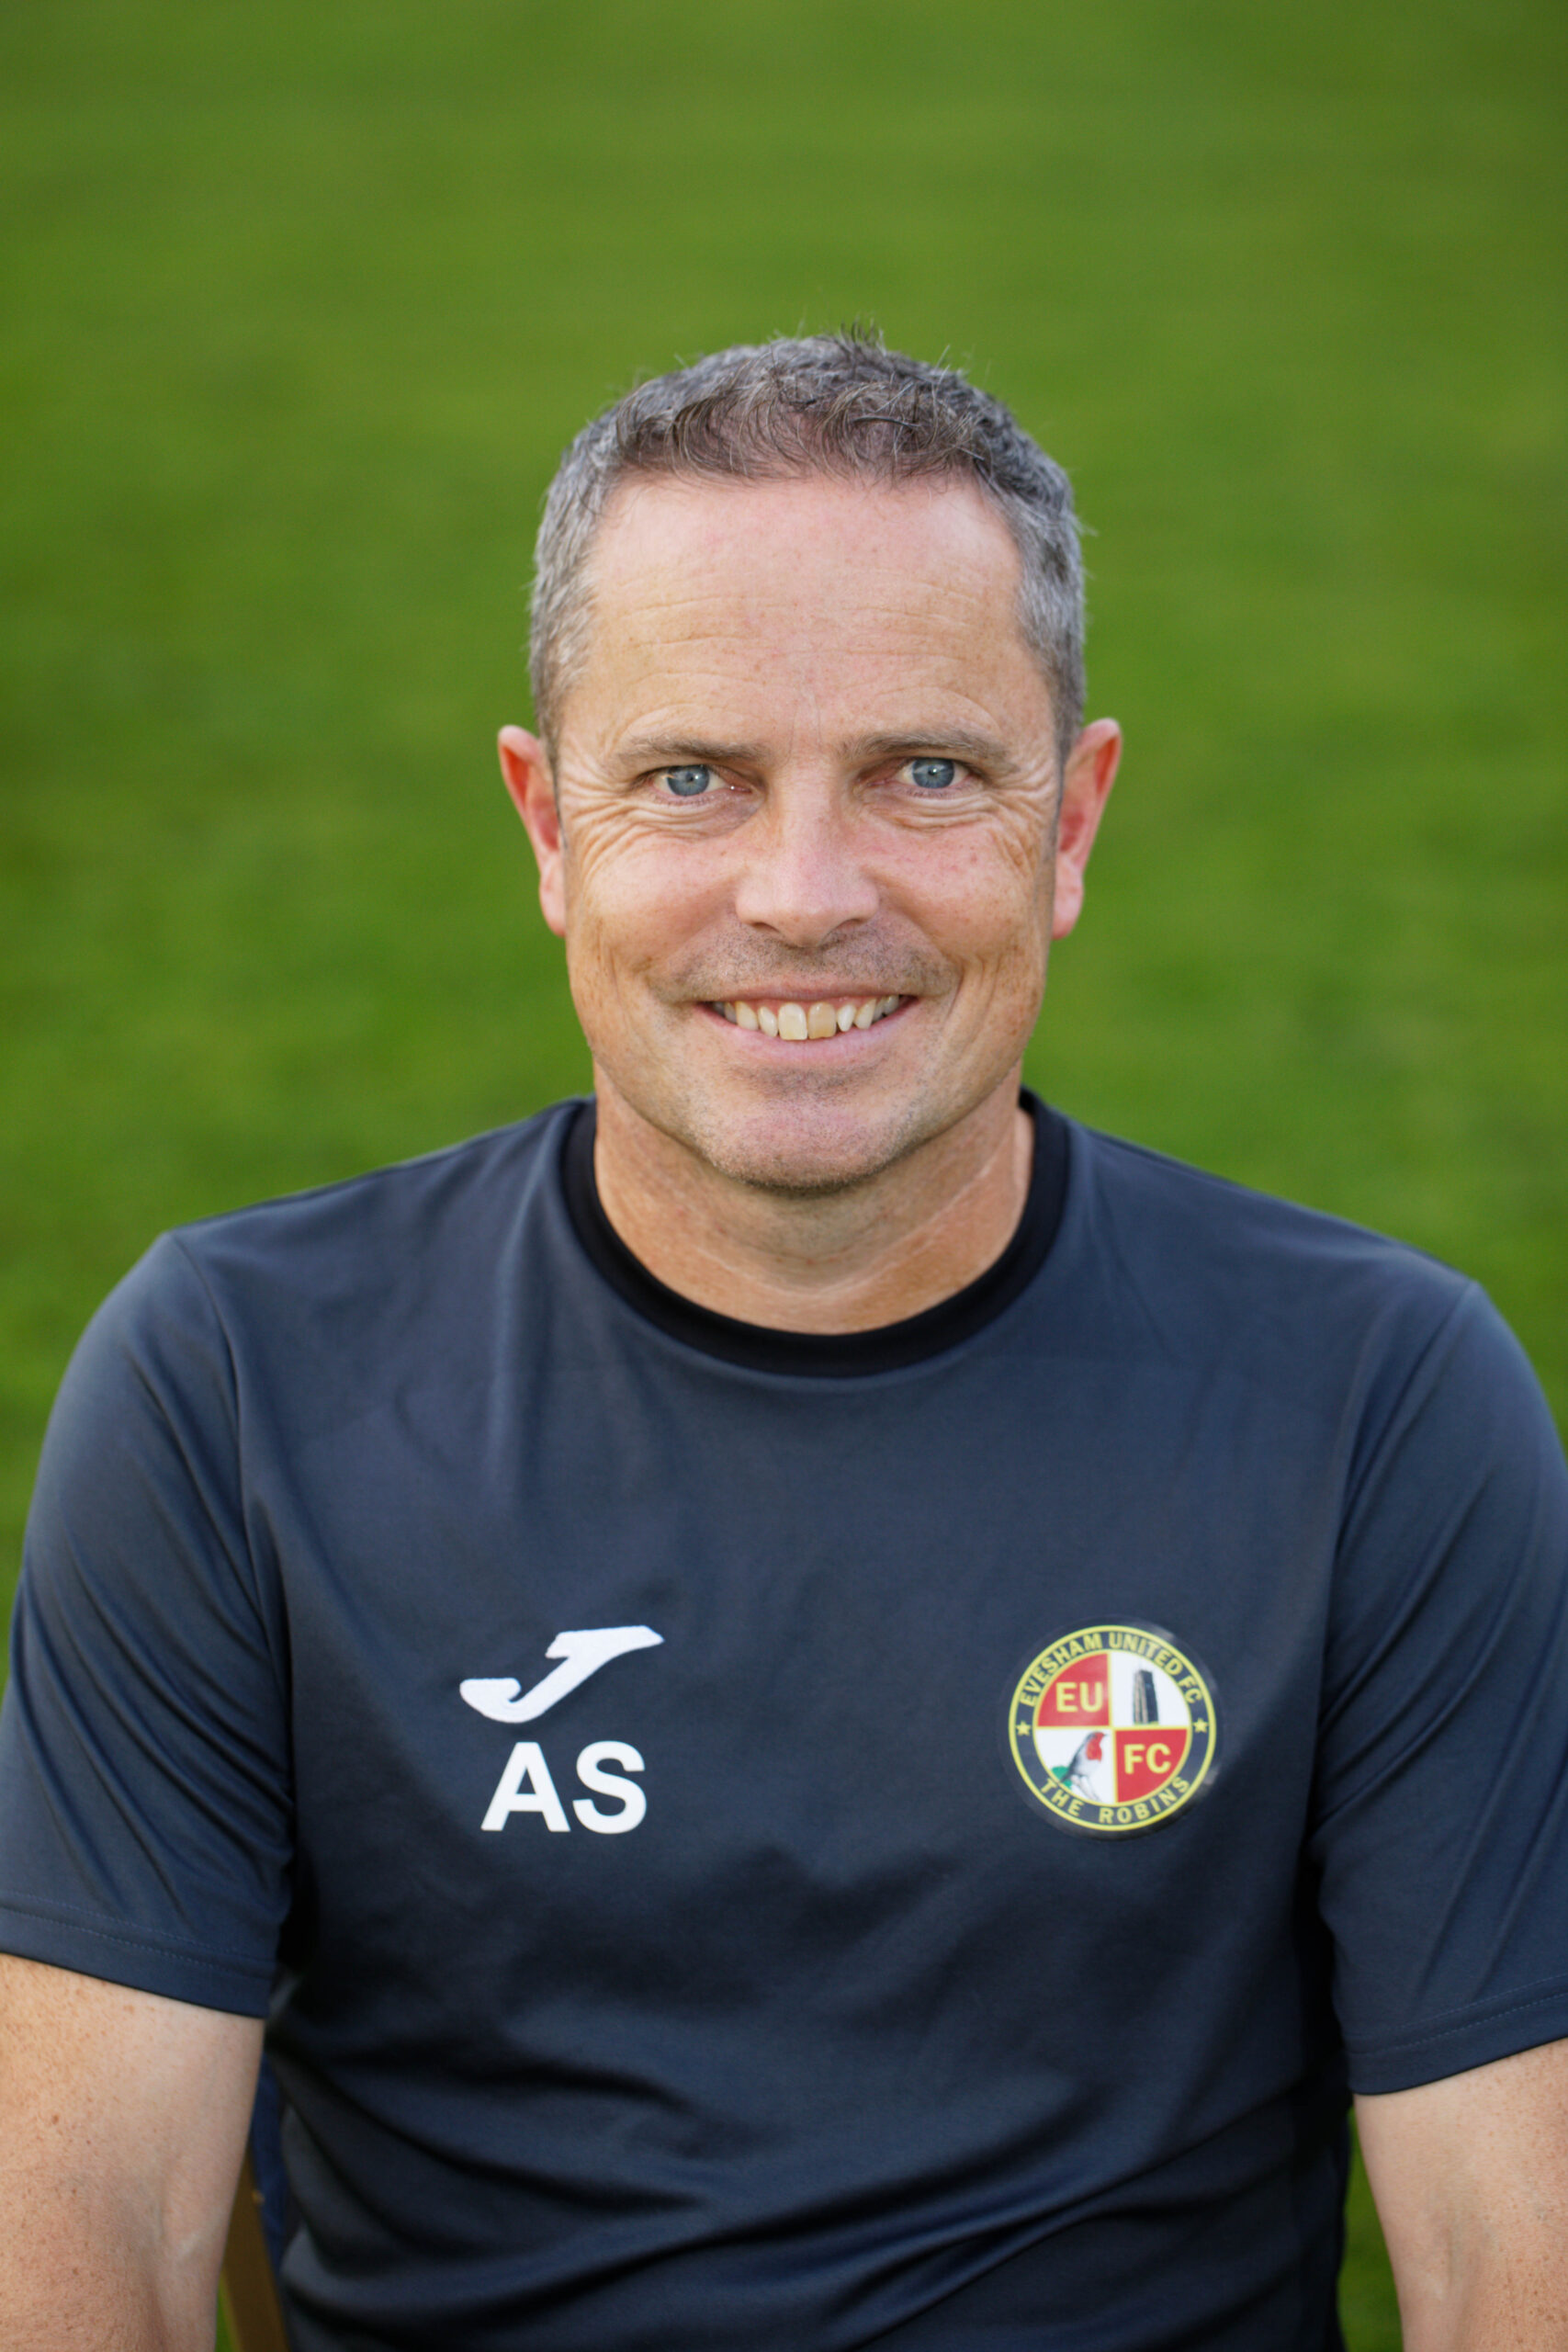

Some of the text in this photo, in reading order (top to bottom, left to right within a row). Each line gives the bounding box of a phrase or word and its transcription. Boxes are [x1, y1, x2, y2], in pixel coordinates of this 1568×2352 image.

[1020, 1632, 1202, 1707] EVESHAM UNITED FC
[1055, 1681, 1103, 1713] EU
[1123, 1743, 1171, 1774] FC
[480, 1740, 647, 1834] AS
[1041, 1776, 1190, 1824] THE ROBINS
